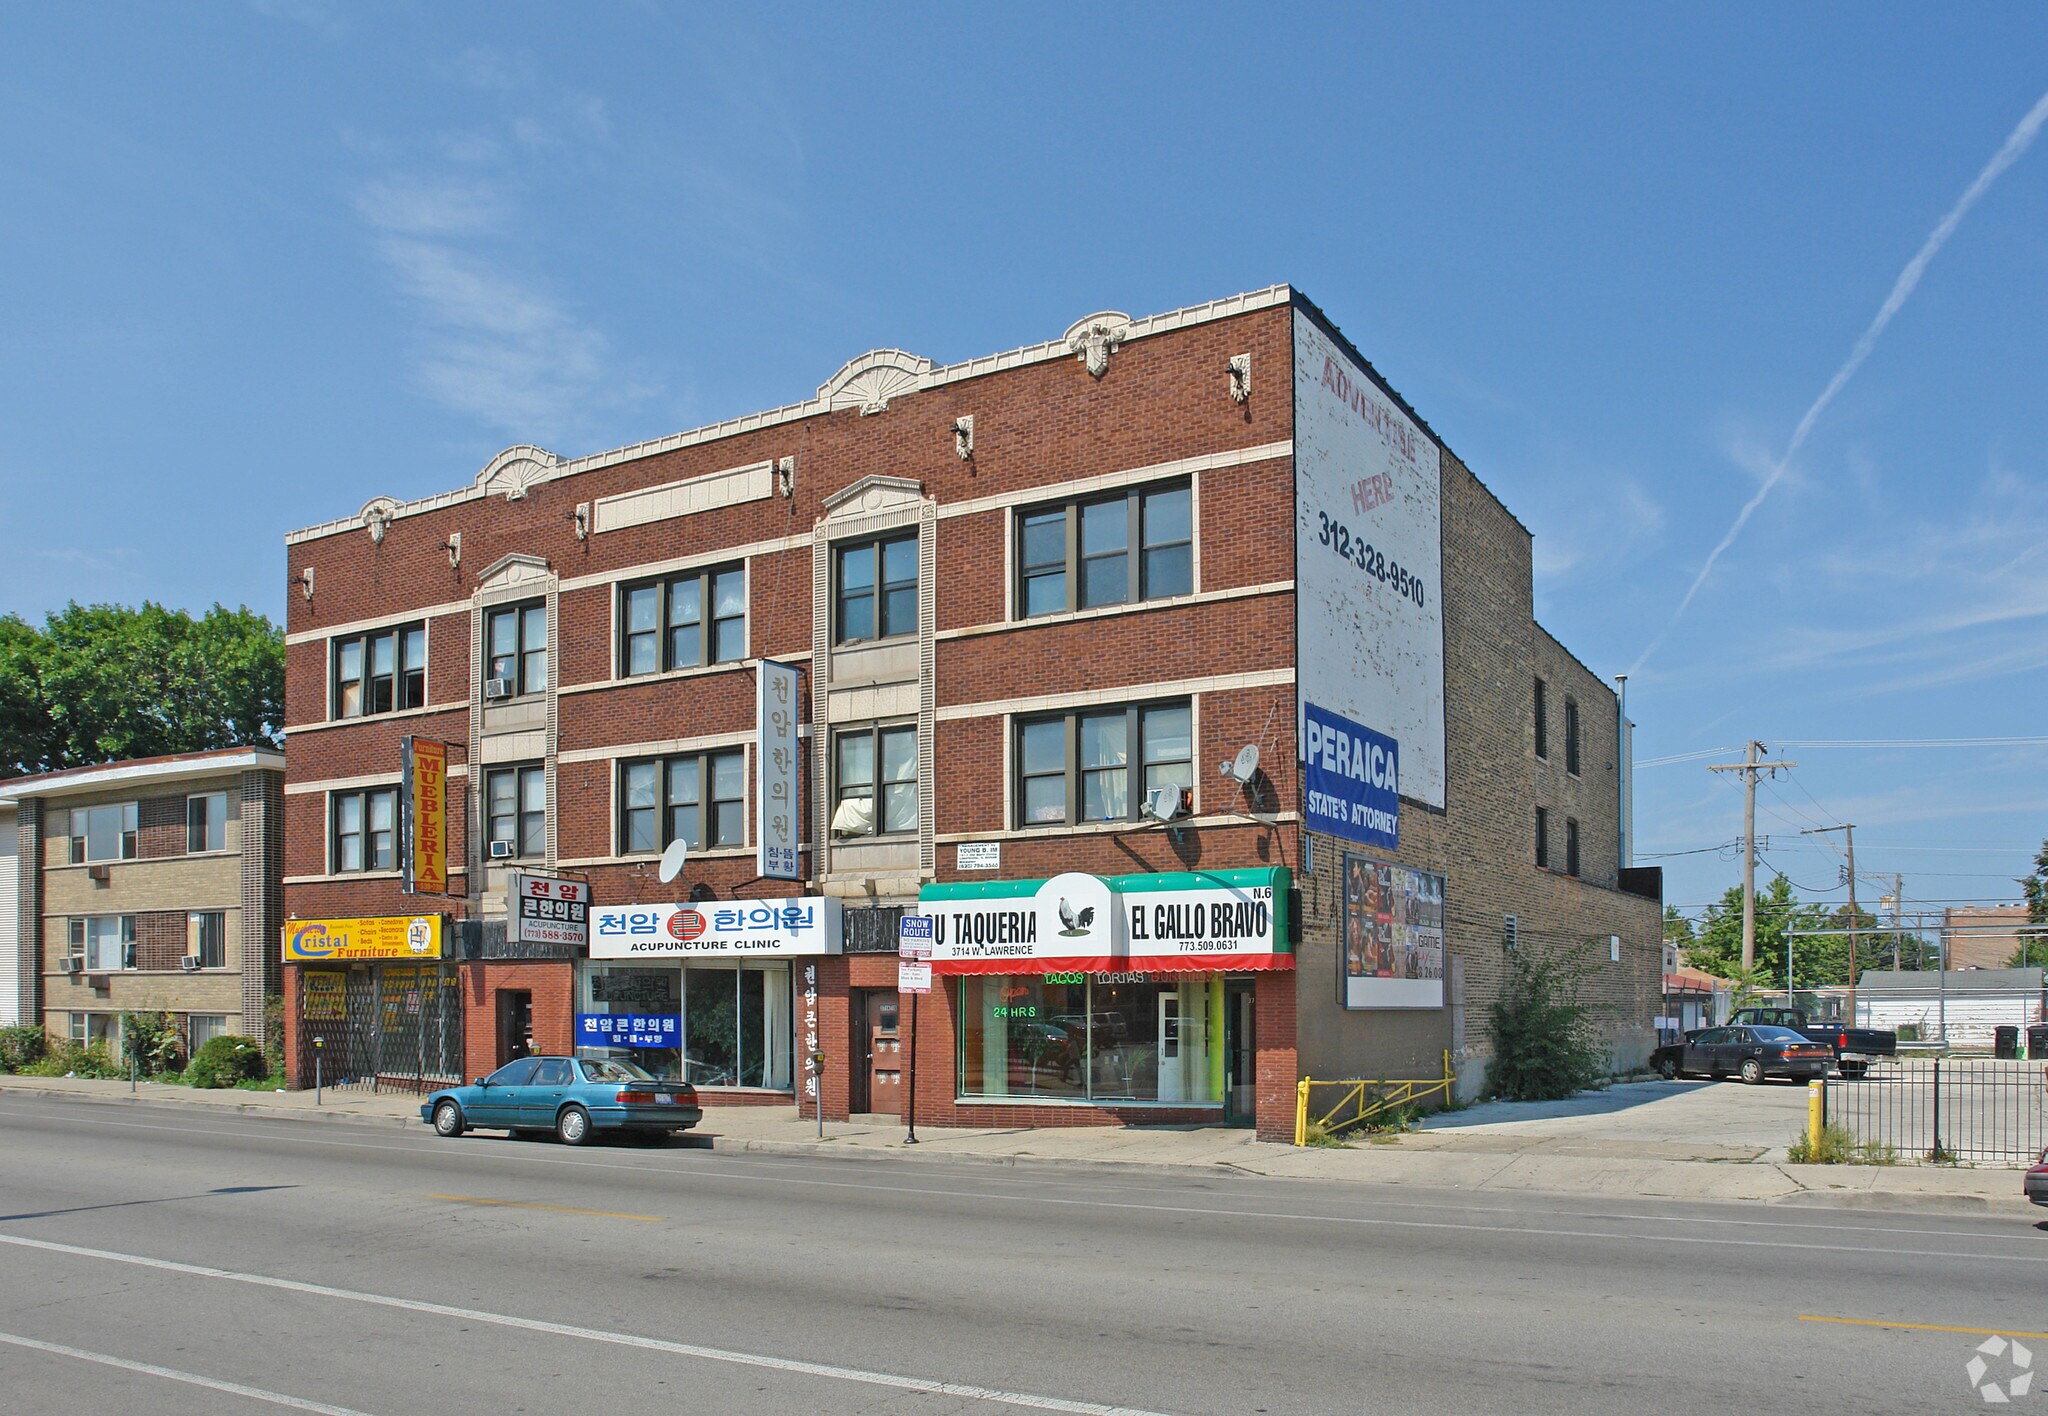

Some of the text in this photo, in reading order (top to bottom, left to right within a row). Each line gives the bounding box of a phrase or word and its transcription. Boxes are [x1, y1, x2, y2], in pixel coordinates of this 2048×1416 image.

[1350, 469, 1395, 517] HERE
[1318, 510, 1425, 608] 312-328-9510
[1307, 718, 1398, 794] PERAICA
[417, 756, 441, 882] MUEBLERIA
[1308, 789, 1398, 836] STATE'S ATTORNEY
[530, 881, 579, 901] 천암
[1253, 887, 1272, 900] N.6
[528, 920, 579, 932] ACUPUNCTURE
[599, 906, 814, 938] 천암 큰 한의원
[905, 919, 929, 929] SNOW
[953, 911, 1036, 949] TAQUERIA
[1132, 905, 1149, 940] EL
[1154, 902, 1205, 940] GALLO
[1211, 901, 1267, 938] BRAVO
[360, 928, 377, 936] Chairs
[524, 928, 584, 942] (773) 588-3570
[903, 928, 931, 937] ROUTE
[292, 924, 348, 957] Cristal
[630, 939, 781, 952] ACUPUNCTURE CLINIC
[1179, 940, 1238, 951] 773.509.0631
[337, 945, 399, 958] Furniture
[951, 945, 1033, 956] 3714 W. LAWRENCE
[1044, 972, 1085, 985] TACOS
[1096, 972, 1144, 984] TORTAS
[993, 1006, 1036, 1018] 24 HRS
[584, 1018, 613, 1033] 천암
[633, 1018, 675, 1033] 한의원
